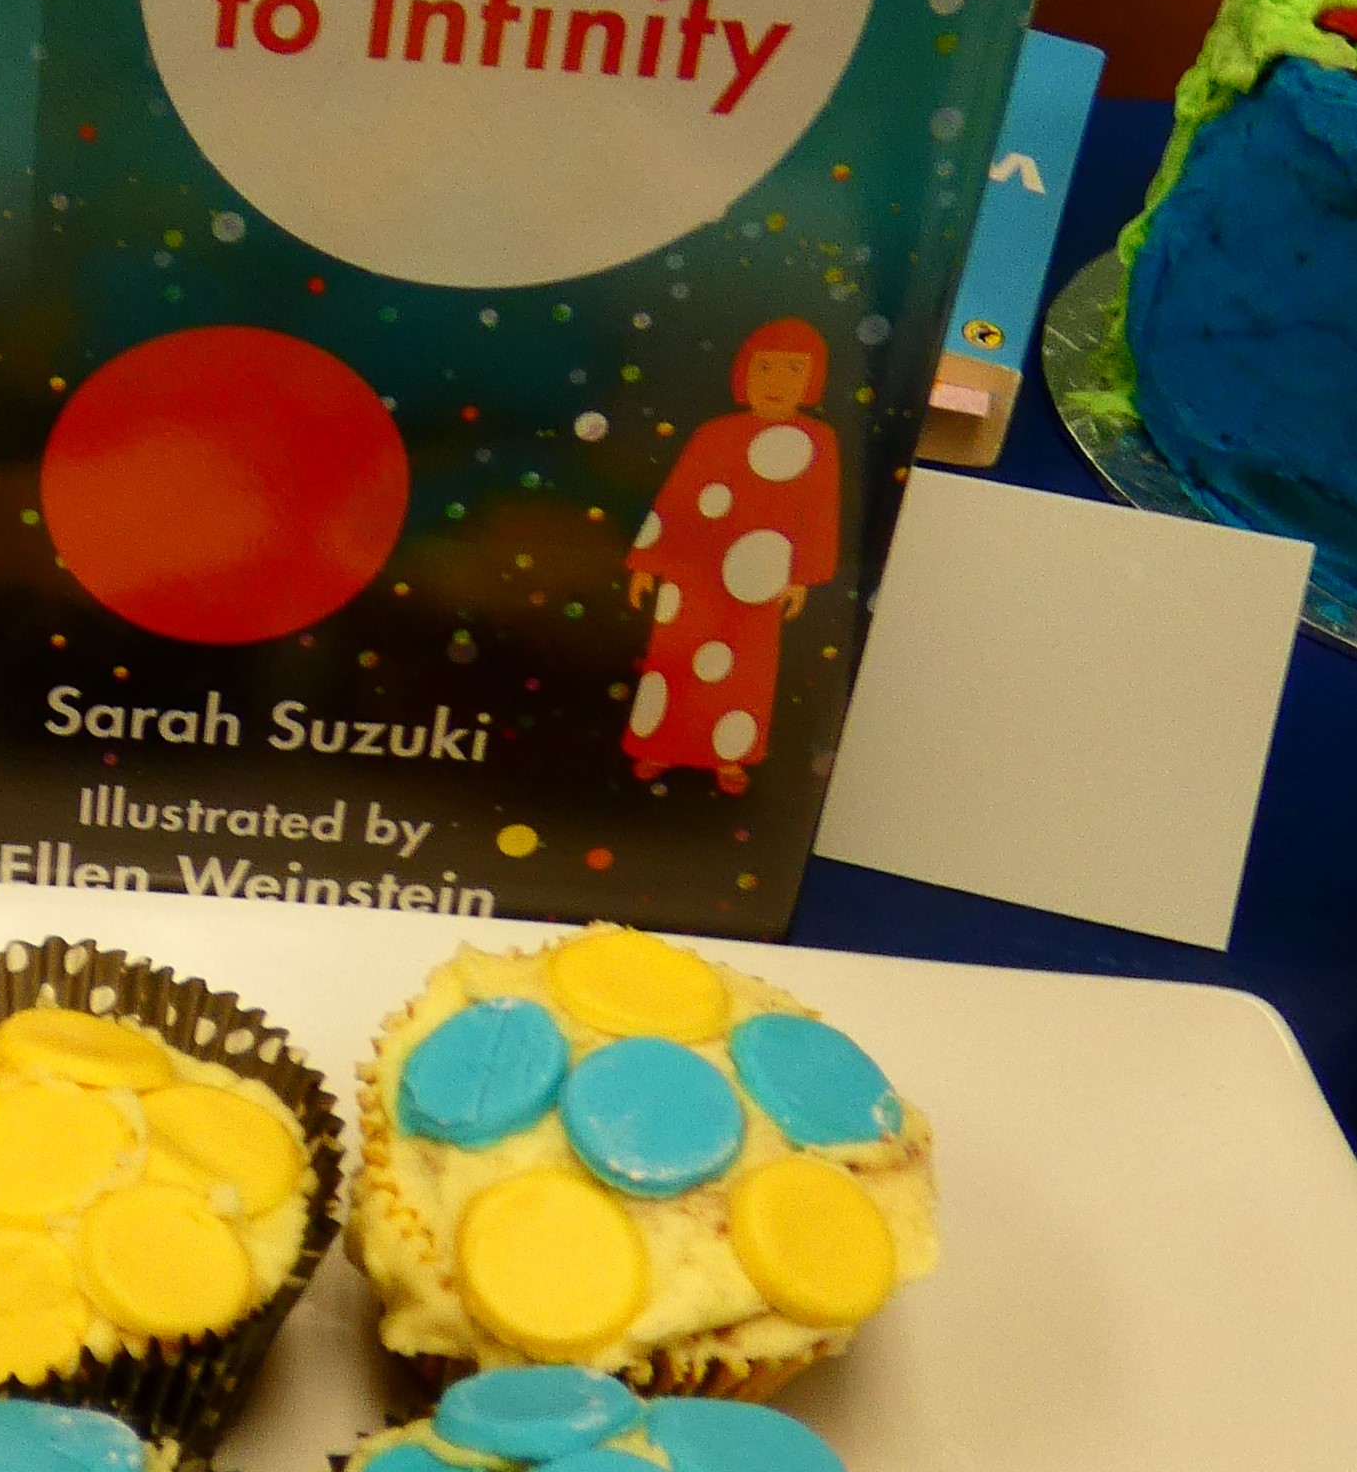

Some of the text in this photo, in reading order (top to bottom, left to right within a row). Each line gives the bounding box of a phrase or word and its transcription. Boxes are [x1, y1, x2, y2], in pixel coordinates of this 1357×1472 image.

[44, 684, 490, 763] Sarah Suzuki
[78, 784, 434, 859] Illustrated by
[176, 853, 496, 919] Weinstein
